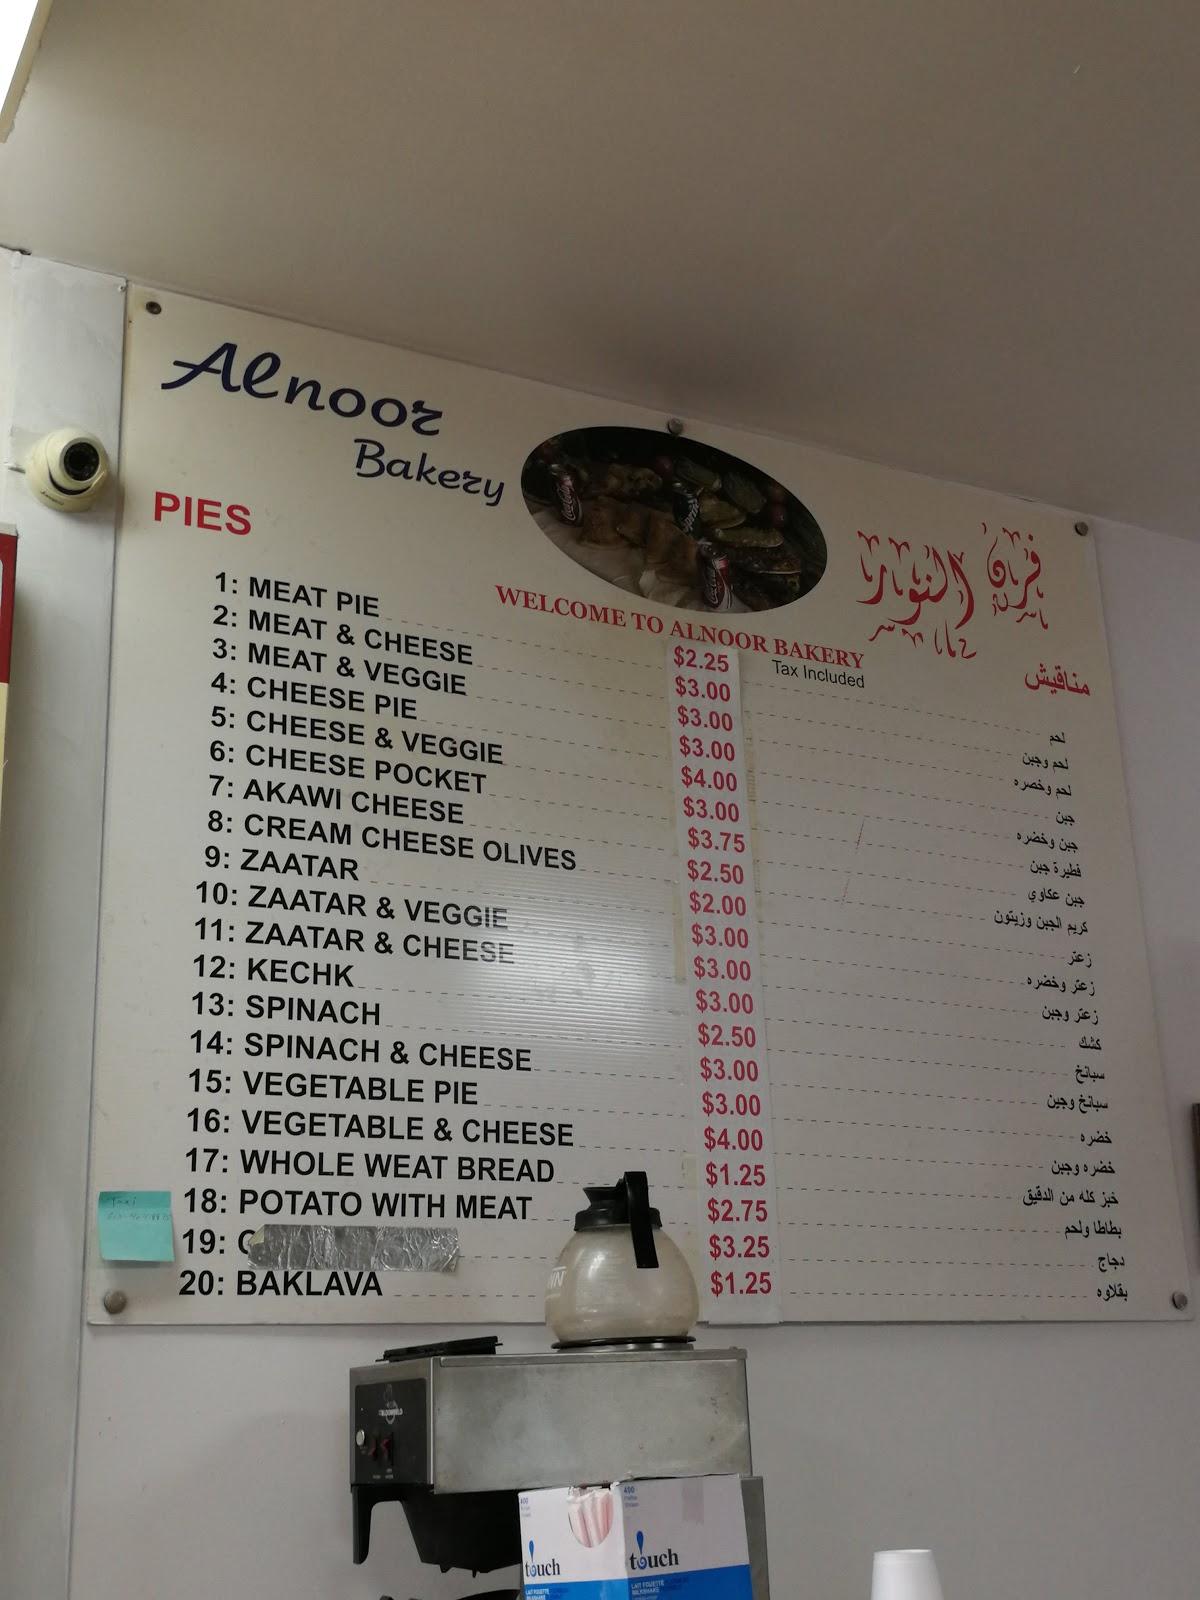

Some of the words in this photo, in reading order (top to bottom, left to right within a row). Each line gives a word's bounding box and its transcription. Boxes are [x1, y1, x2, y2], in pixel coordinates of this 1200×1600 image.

[160, 342, 443, 437] Alnoor
[353, 438, 505, 507] Bakery
[152, 490, 253, 537] PIES
[215, 571, 238, 595] 1:
[249, 576, 327, 609] MEAT
[337, 591, 380, 618] PIE
[213, 604, 237, 627] 2:
[249, 608, 327, 641] MEAT
[336, 623, 356, 646] &
[364, 628, 473, 666] CHEESE
[495, 584, 627, 628] WELCOME
[631, 612, 664, 635] TO
[670, 620, 768, 653] ALNOOR
[774, 638, 864, 669] BAKERY
[212, 637, 237, 661] 3:
[248, 642, 328, 673] MEAT
[336, 656, 356, 679] &
[363, 659, 468, 697] VEGGIE
[673, 646, 730, 673] $2.25
[771, 659, 799, 678] Tax
[803, 664, 865, 689] Included
[674, 675, 731, 704] $3.00
[1025, 663, 1090, 696] مناقيش
[210, 672, 236, 694] 4:
[247, 676, 365, 713] CHEESE
[375, 693, 418, 720] PIE
[677, 704, 733, 733] $3.00
[210, 705, 235, 729] 5:
[247, 710, 365, 746] CHEESE
[375, 727, 394, 750] &
[401, 730, 504, 765] VEGGIE
[678, 735, 736, 764] $3.00
[210, 739, 234, 764] 6:
[245, 744, 365, 779] CHEESE
[375, 759, 487, 794] POCKET
[680, 765, 737, 793] $4.00
[208, 774, 233, 798] 7:
[242, 778, 341, 810] AKAWI
[351, 791, 464, 825] CHEESE
[683, 795, 741, 822] $3.00
[207, 809, 232, 834] 8:
[244, 813, 352, 846] CREAM
[361, 826, 474, 859] CHEESE
[483, 840, 576, 871] OLIVES
[687, 825, 746, 854] $3.75
[204, 845, 229, 869] 9:
[240, 848, 359, 881] ZAATAR
[687, 858, 745, 885] $2.50
[196, 880, 238, 906] 10:
[248, 885, 367, 917] ZAATAR
[376, 896, 395, 920] &
[404, 899, 508, 929] VEGGIE
[687, 889, 747, 918] $2.00
[195, 916, 234, 942] 11:
[245, 921, 365, 953] ZAATAR
[374, 931, 394, 955] &
[403, 933, 514, 964] CHEESE
[691, 922, 749, 949] $3.00
[193, 954, 235, 980] 12:
[247, 957, 354, 988] KECHK
[693, 954, 751, 982] $3.00
[192, 991, 234, 1017] 13:
[245, 994, 380, 1026] SPINACH
[695, 987, 754, 1015] $3.00
[697, 1022, 757, 1049] $2.50
[190, 1029, 232, 1056] 14:
[244, 1032, 380, 1063] SPINACH
[389, 1040, 410, 1065] &
[419, 1042, 531, 1072] CHEESE
[699, 1056, 761, 1083] $3.00
[188, 1068, 232, 1094] 15:
[242, 1070, 424, 1103] VEGETABLE
[434, 1080, 478, 1106] PIE
[701, 1090, 762, 1117] $3.00
[187, 1107, 230, 1134] 16:
[241, 1109, 424, 1141] VEGETABLE
[433, 1117, 453, 1142] &
[462, 1118, 574, 1147] CHEESE
[703, 1125, 764, 1152] $4.00
[186, 1147, 228, 1173] 17:
[239, 1149, 355, 1177] WHOLE
[364, 1153, 449, 1179] WEAT
[457, 1156, 555, 1183] BREAD
[705, 1160, 767, 1188] $1.25
[184, 1187, 227, 1214] 18:
[239, 1188, 362, 1217] POTATO
[371, 1192, 445, 1219] WITH
[456, 1194, 533, 1220] MEAT
[706, 1197, 769, 1223] $2.75
[183, 1228, 225, 1255] 19:
[708, 1233, 770, 1260] $3.25
[179, 1270, 224, 1296] 20:
[237, 1270, 383, 1297] BAKLAVA
[709, 1270, 772, 1297] $1.25
[525, 1558, 561, 1578] touch
[630, 1548, 680, 1571] touch
